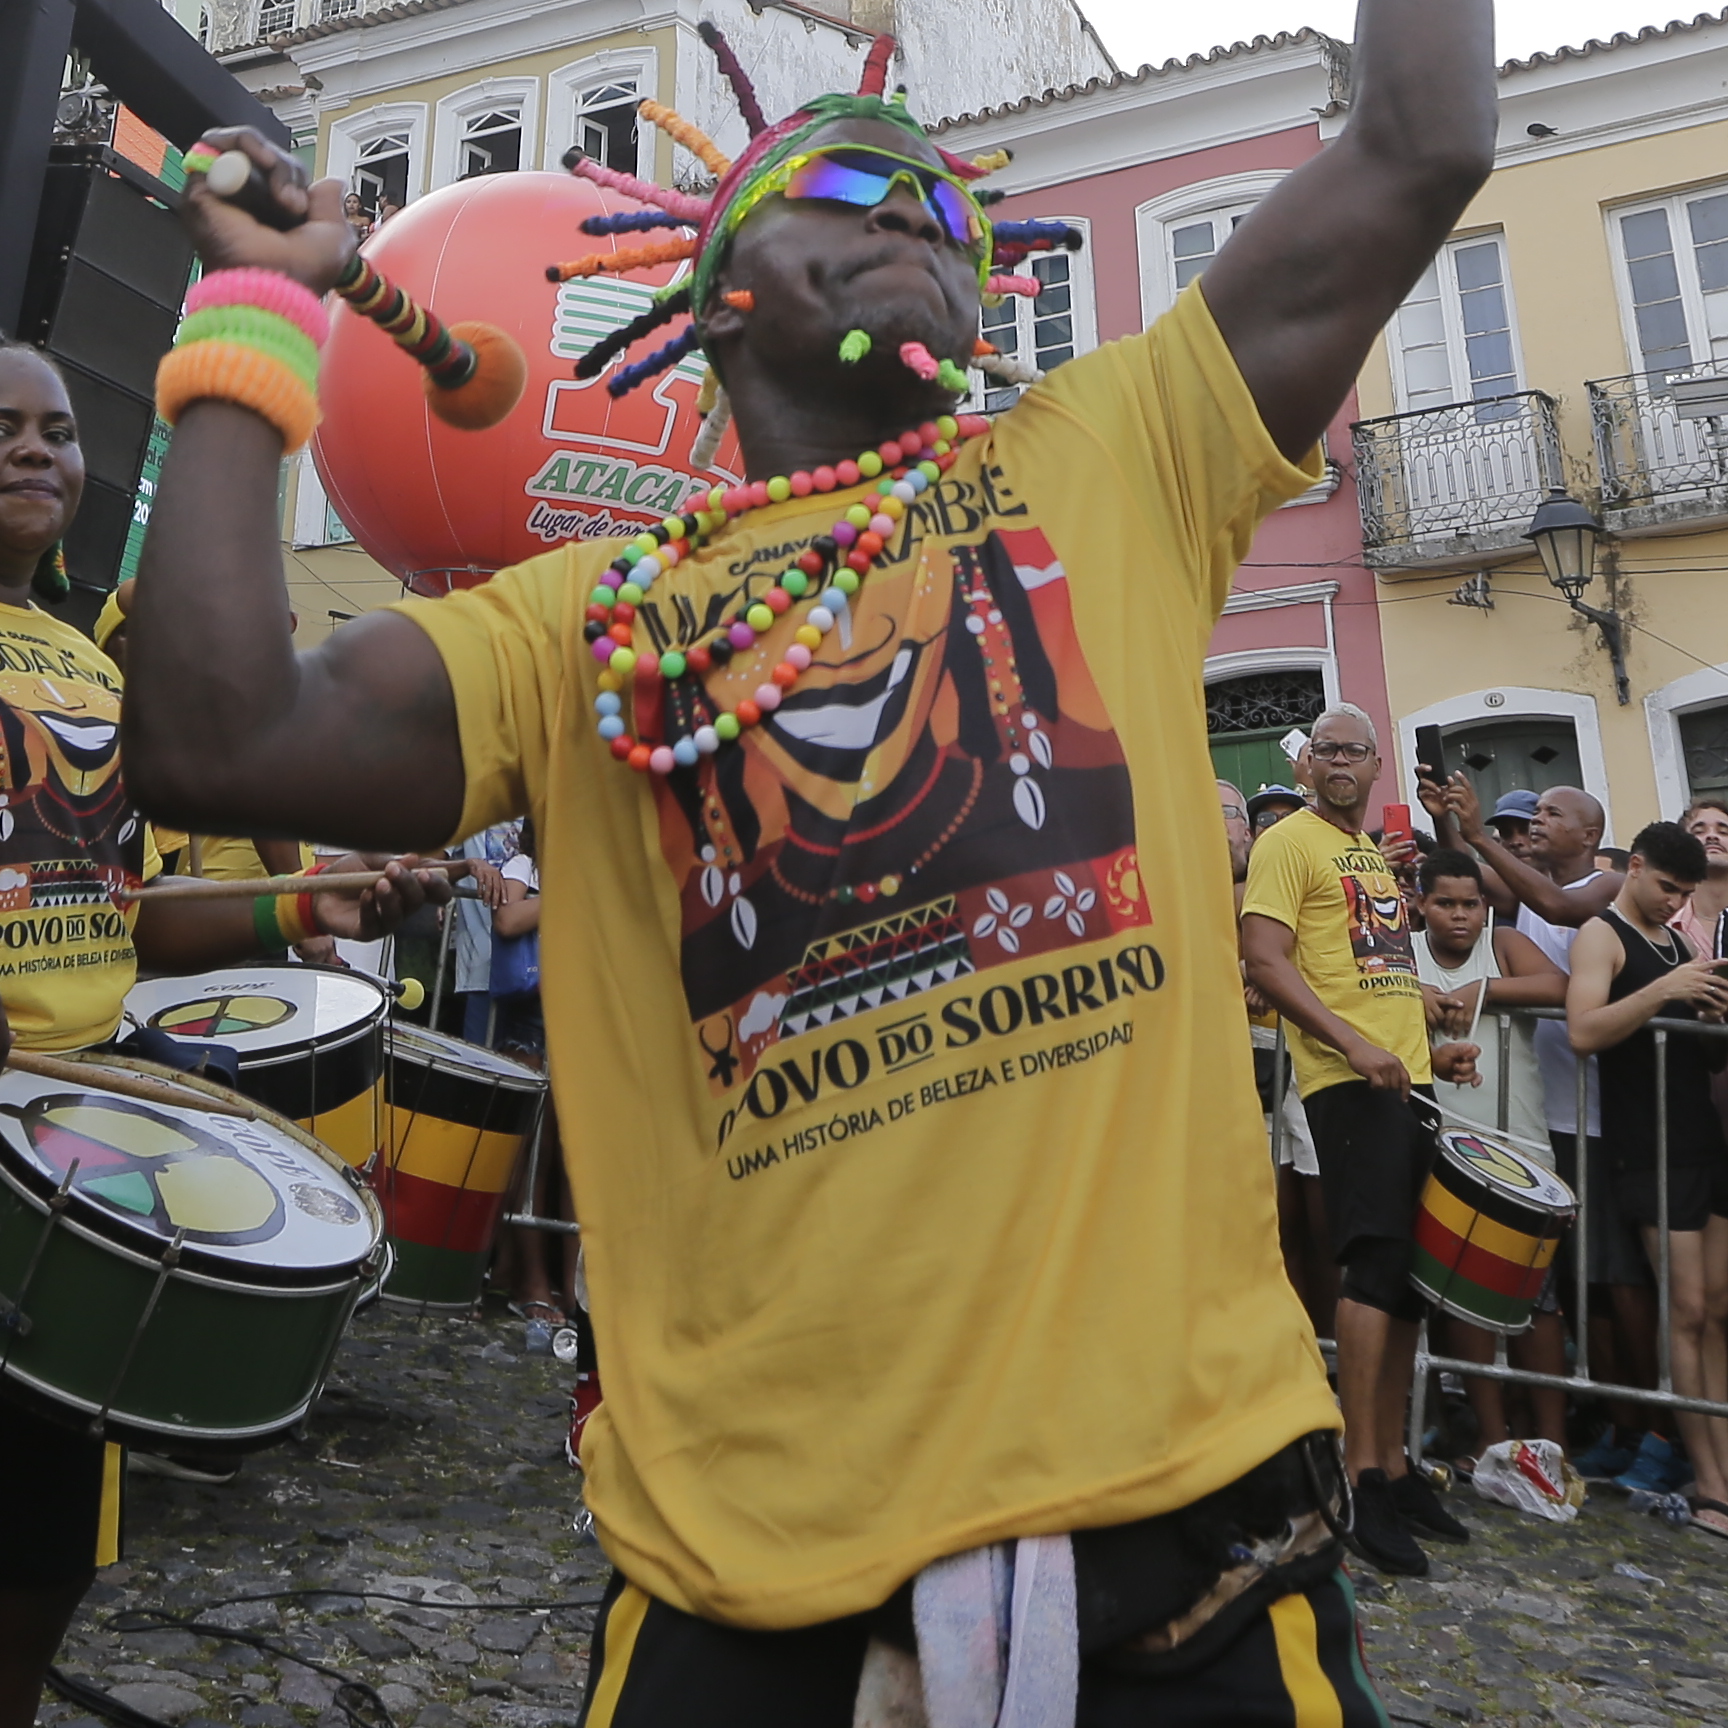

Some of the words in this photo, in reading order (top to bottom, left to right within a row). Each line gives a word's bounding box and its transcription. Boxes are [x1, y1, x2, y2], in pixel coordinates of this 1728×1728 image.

[532, 458, 704, 513] ATACA
[530, 506, 583, 538] Lugar
[583, 514, 608, 537] de
[66, 916, 85, 939] DO
[18, 955, 61, 974] HISTÓRIA
[63, 955, 75, 969] DE
[1359, 978, 1369, 990] O
[736, 1038, 870, 1120] OVO
[877, 1016, 934, 1071] DO
[940, 943, 1166, 1049] SORRISO
[726, 1145, 780, 1181] UMA
[782, 1102, 885, 1160] HISTÓRIA
[887, 1093, 916, 1122] DE
[919, 1066, 998, 1107] BELEZA
[1001, 1059, 1015, 1083] E
[209, 1116, 322, 1181] GOPE
